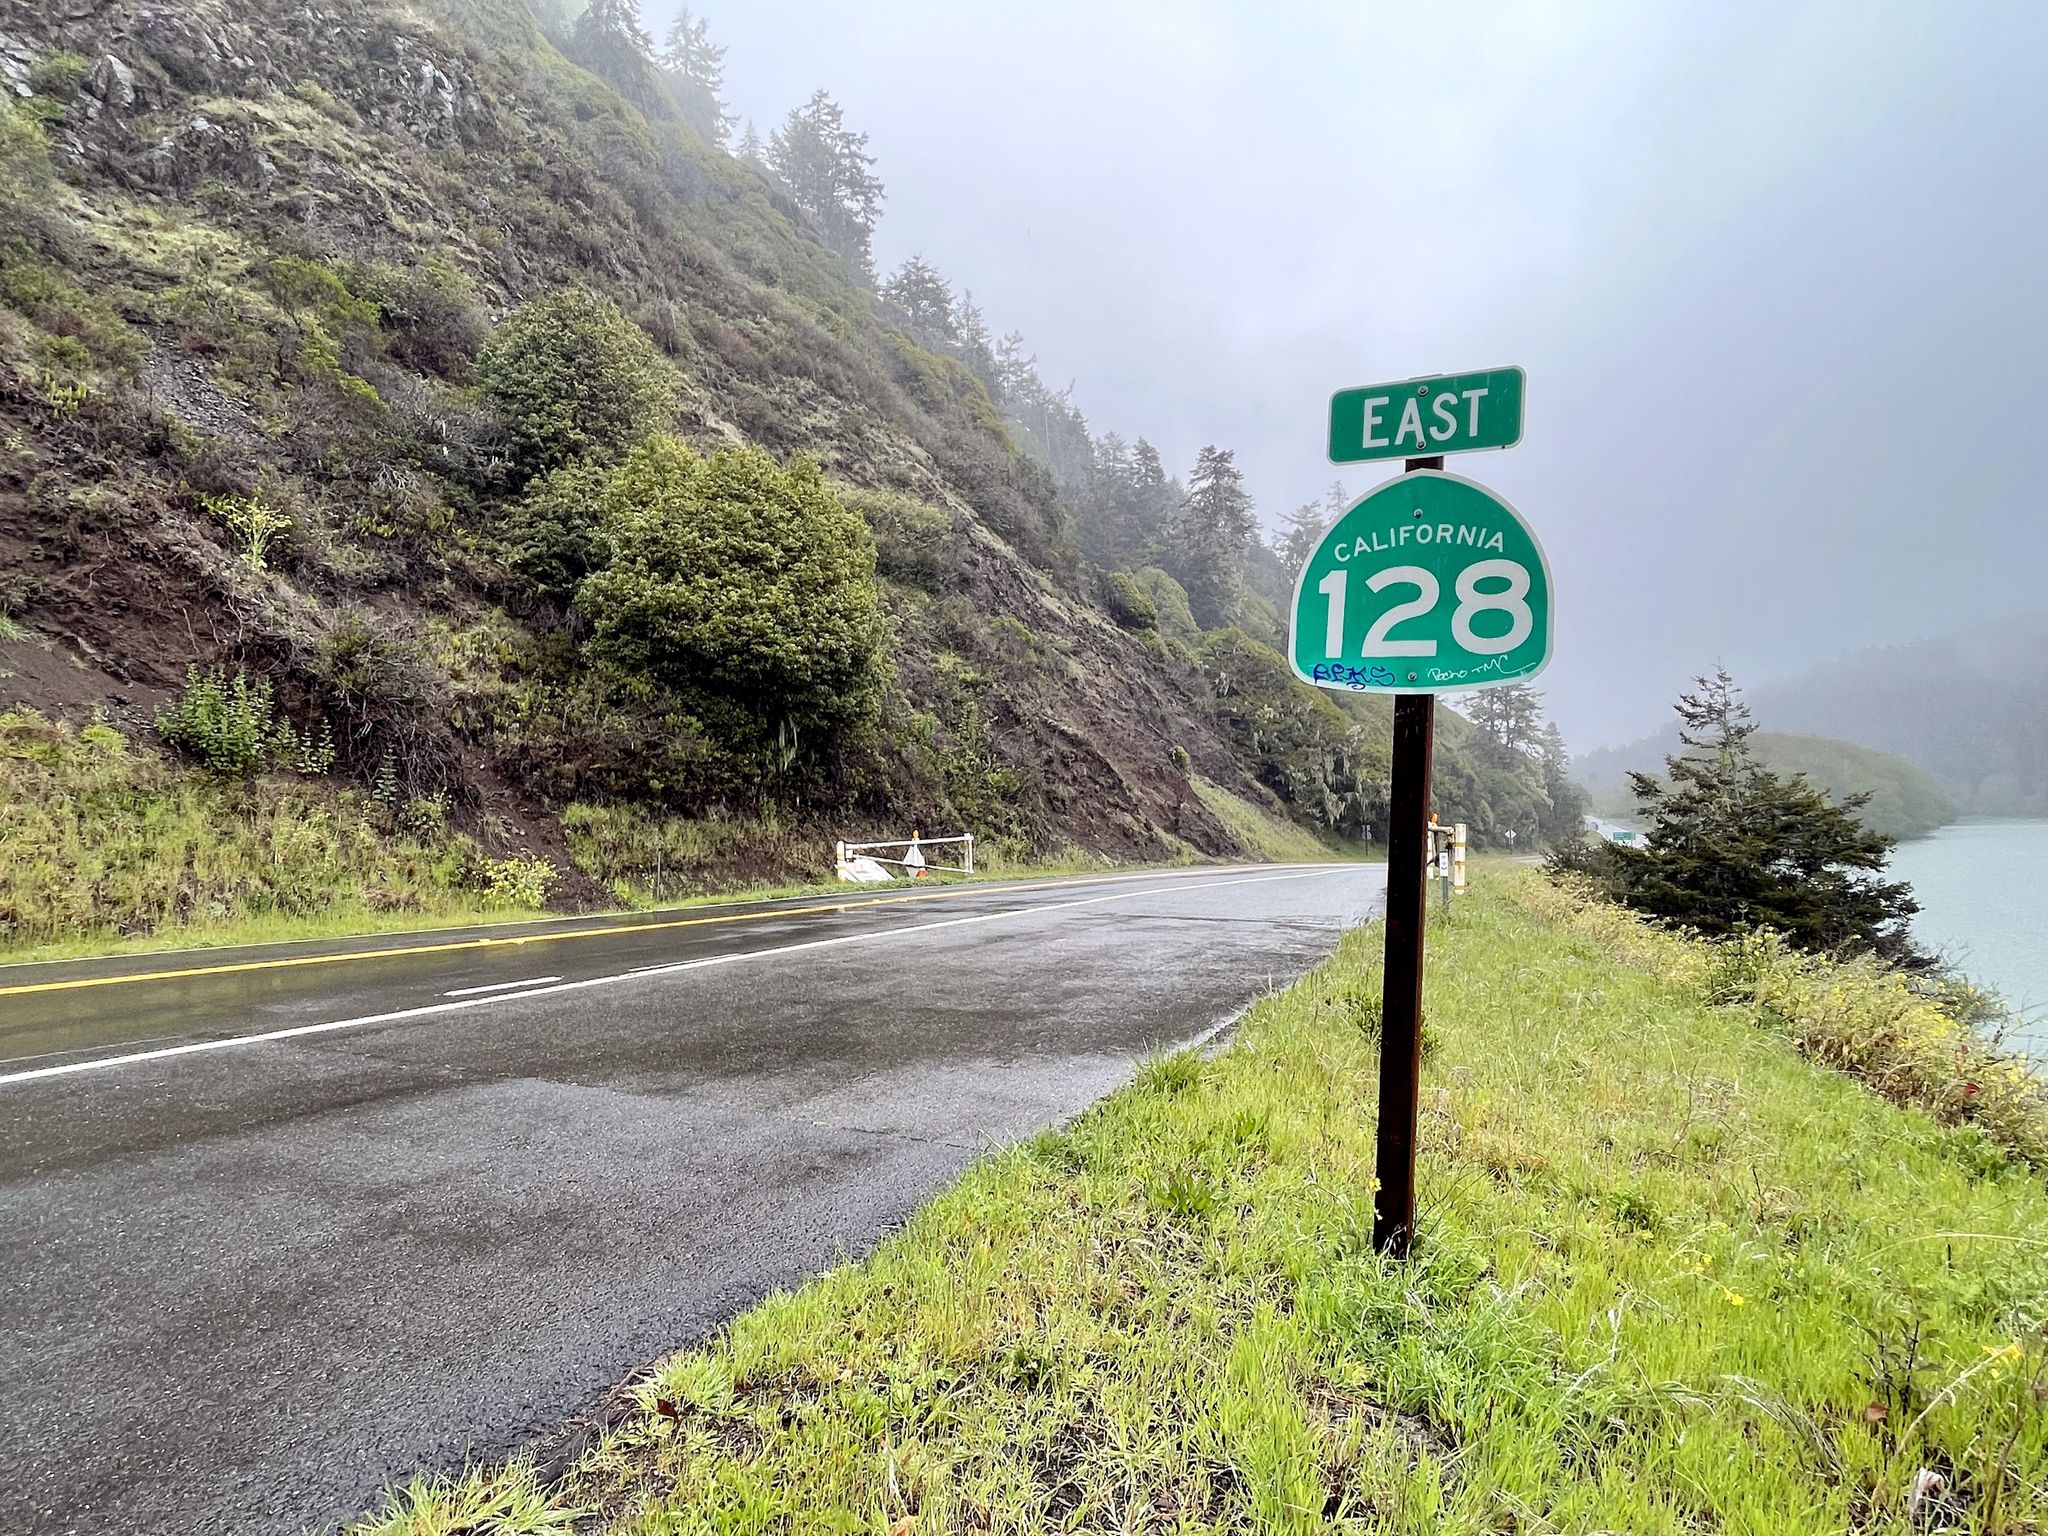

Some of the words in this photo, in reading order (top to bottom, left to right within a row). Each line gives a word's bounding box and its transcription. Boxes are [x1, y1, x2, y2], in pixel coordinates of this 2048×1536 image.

[1362, 388, 1488, 448] EAST
[1334, 523, 1504, 562] CALIFORNIA
[1318, 559, 1533, 659] 128
